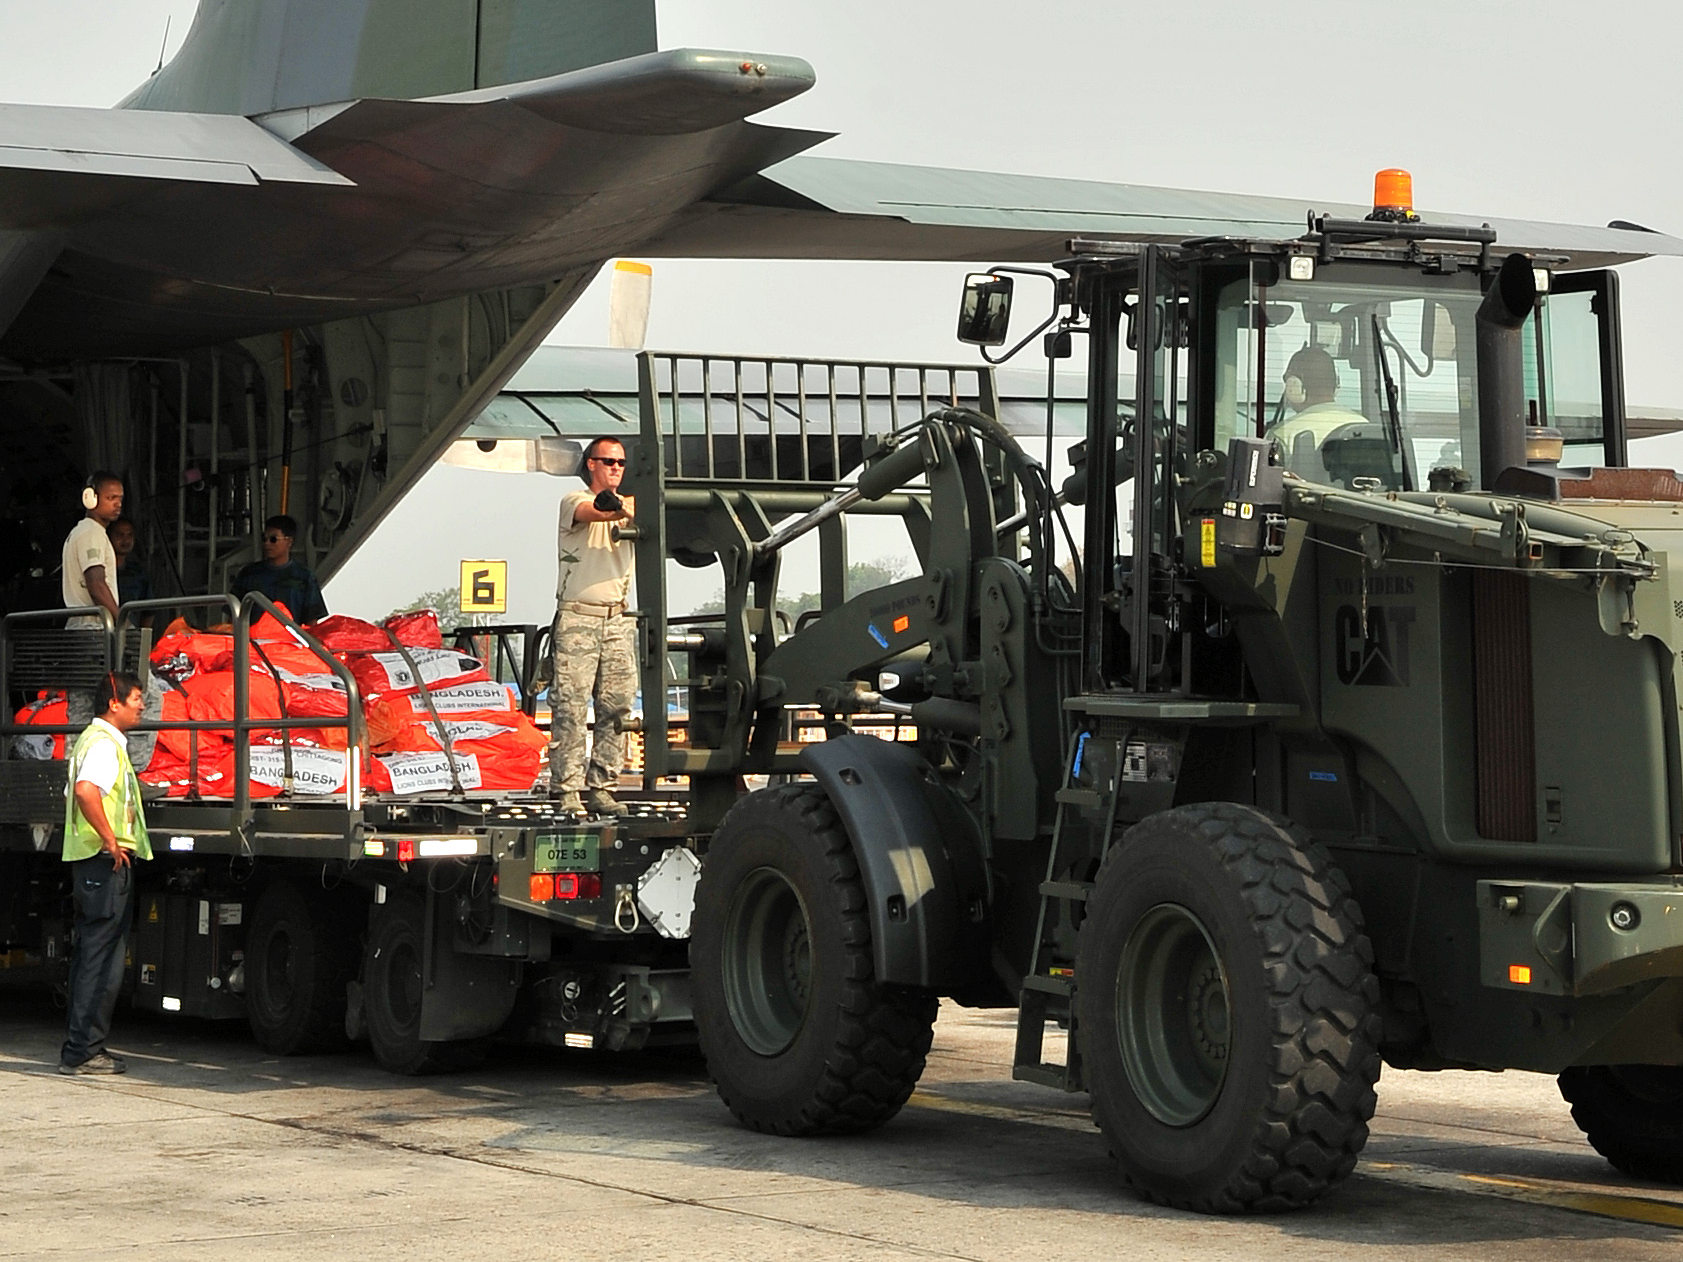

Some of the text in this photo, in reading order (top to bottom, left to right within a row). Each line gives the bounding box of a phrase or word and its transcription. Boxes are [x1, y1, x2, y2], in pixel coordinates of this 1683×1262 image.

[472, 569, 495, 604] 6
[1335, 604, 1416, 687] CAT
[249, 765, 338, 787] BANGADESH
[392, 762, 475, 777] BANGLADSH.
[547, 849, 587, 860] 07E 53
